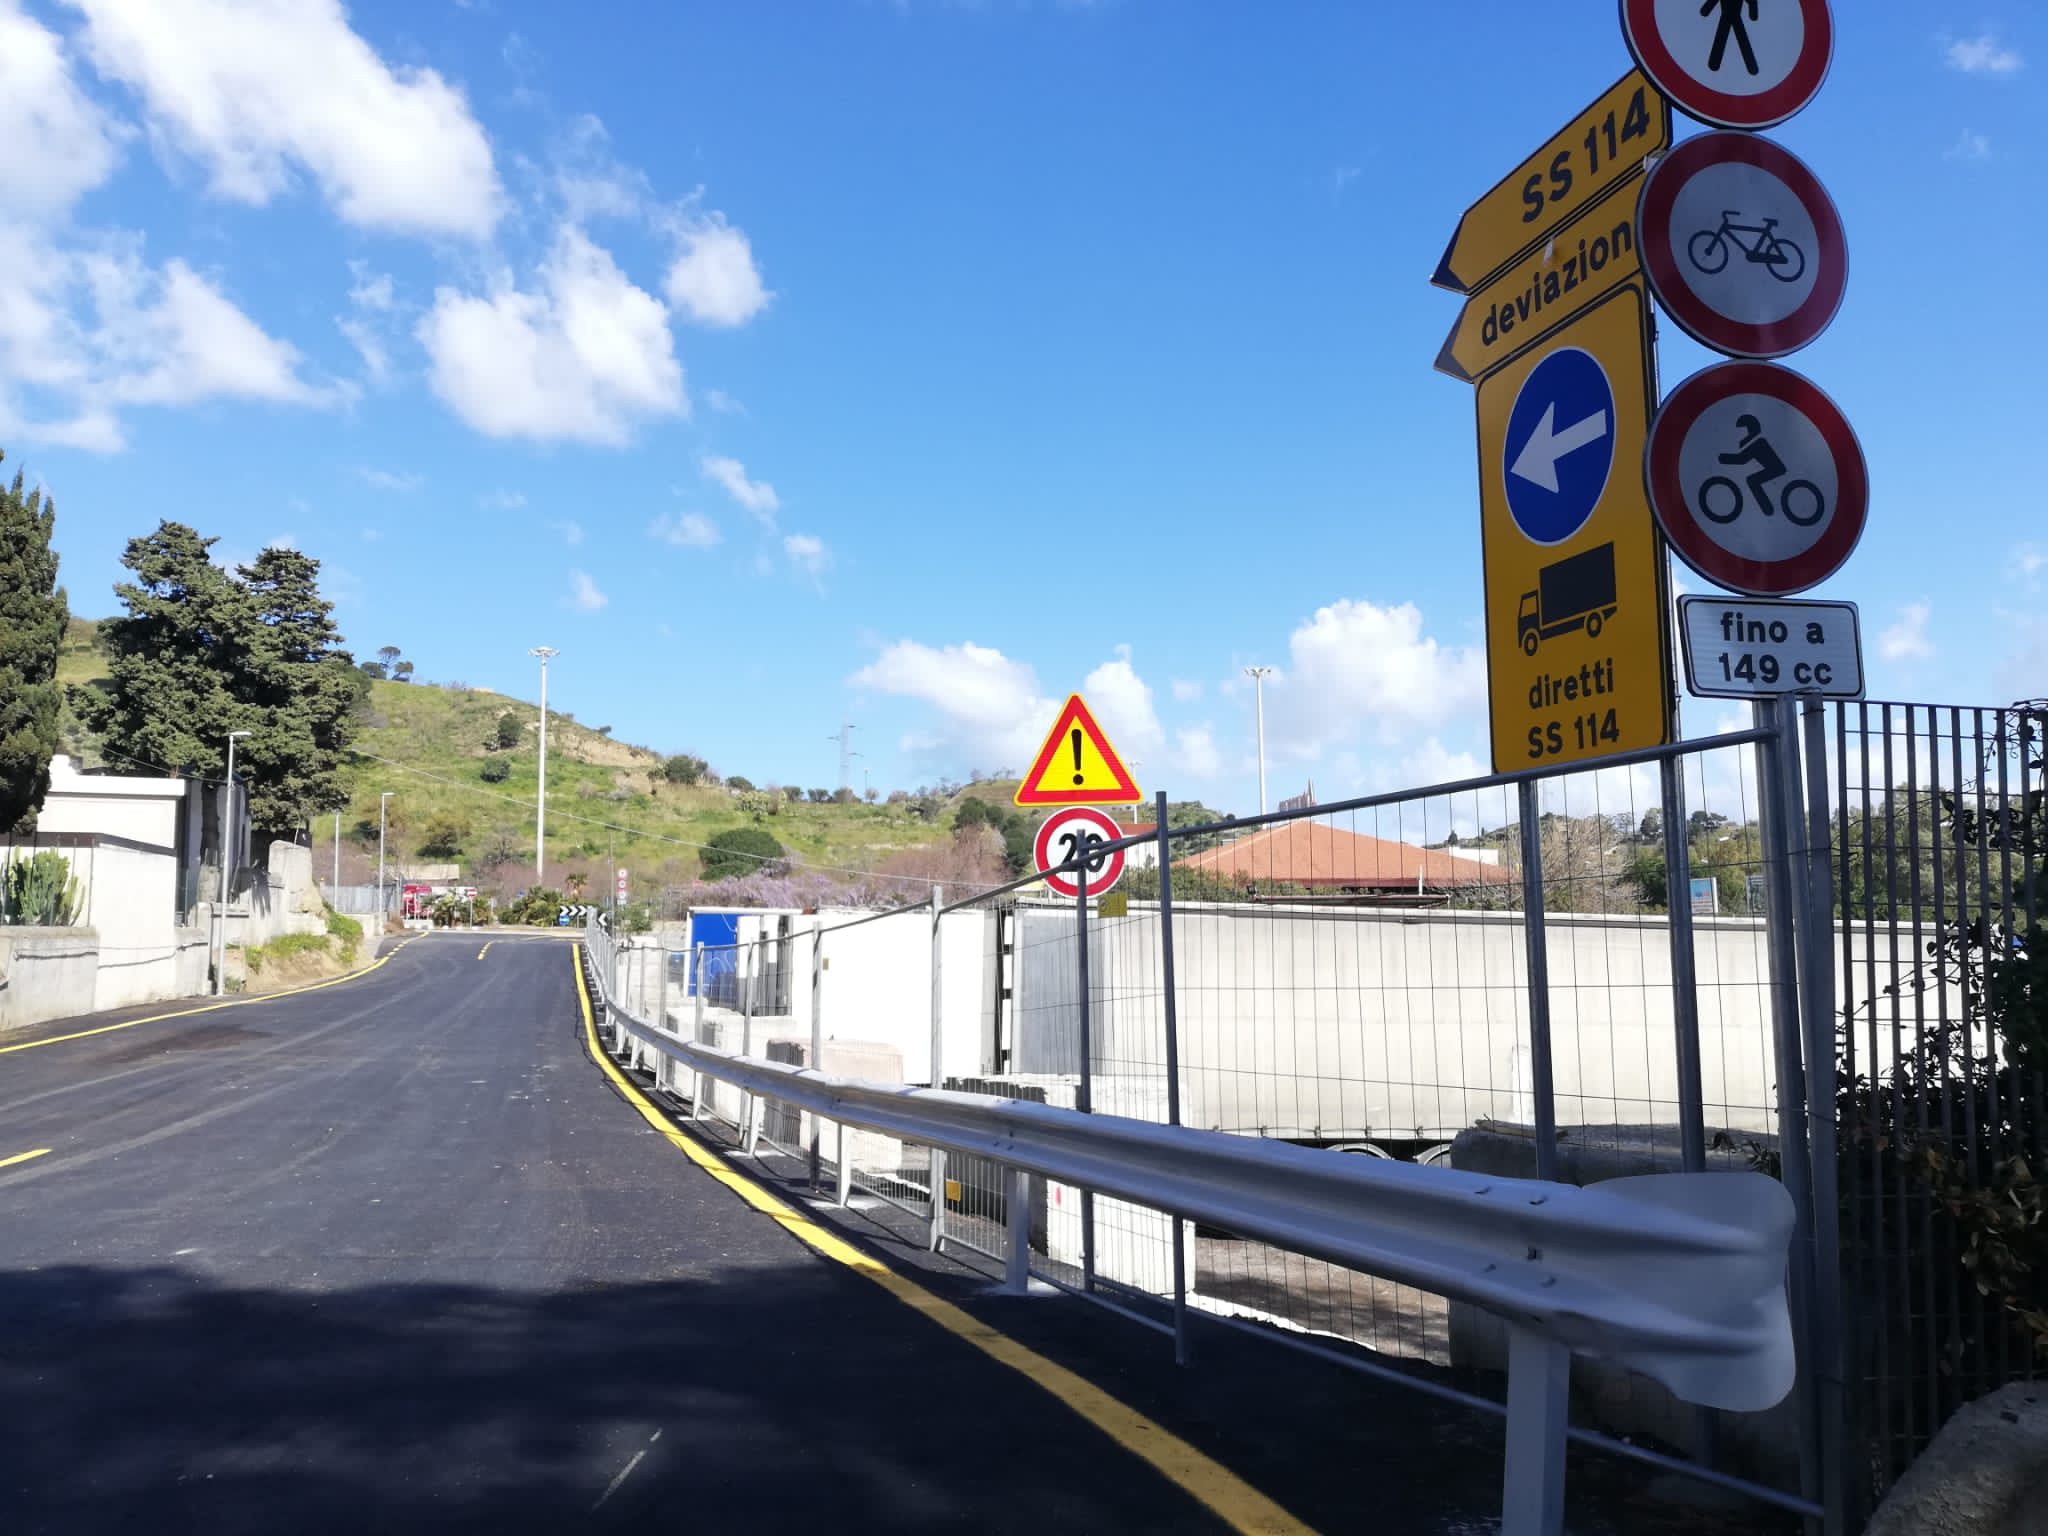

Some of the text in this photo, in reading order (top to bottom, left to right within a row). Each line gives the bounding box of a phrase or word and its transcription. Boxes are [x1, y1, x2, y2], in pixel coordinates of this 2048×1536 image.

[1522, 86, 1650, 223] SS 114
[1482, 221, 1632, 346] deviazion
[1720, 611, 1825, 644] fino a
[1529, 657, 1614, 709] diretti
[1718, 652, 1833, 685] 149 cc
[1528, 708, 1620, 759] SS 114
